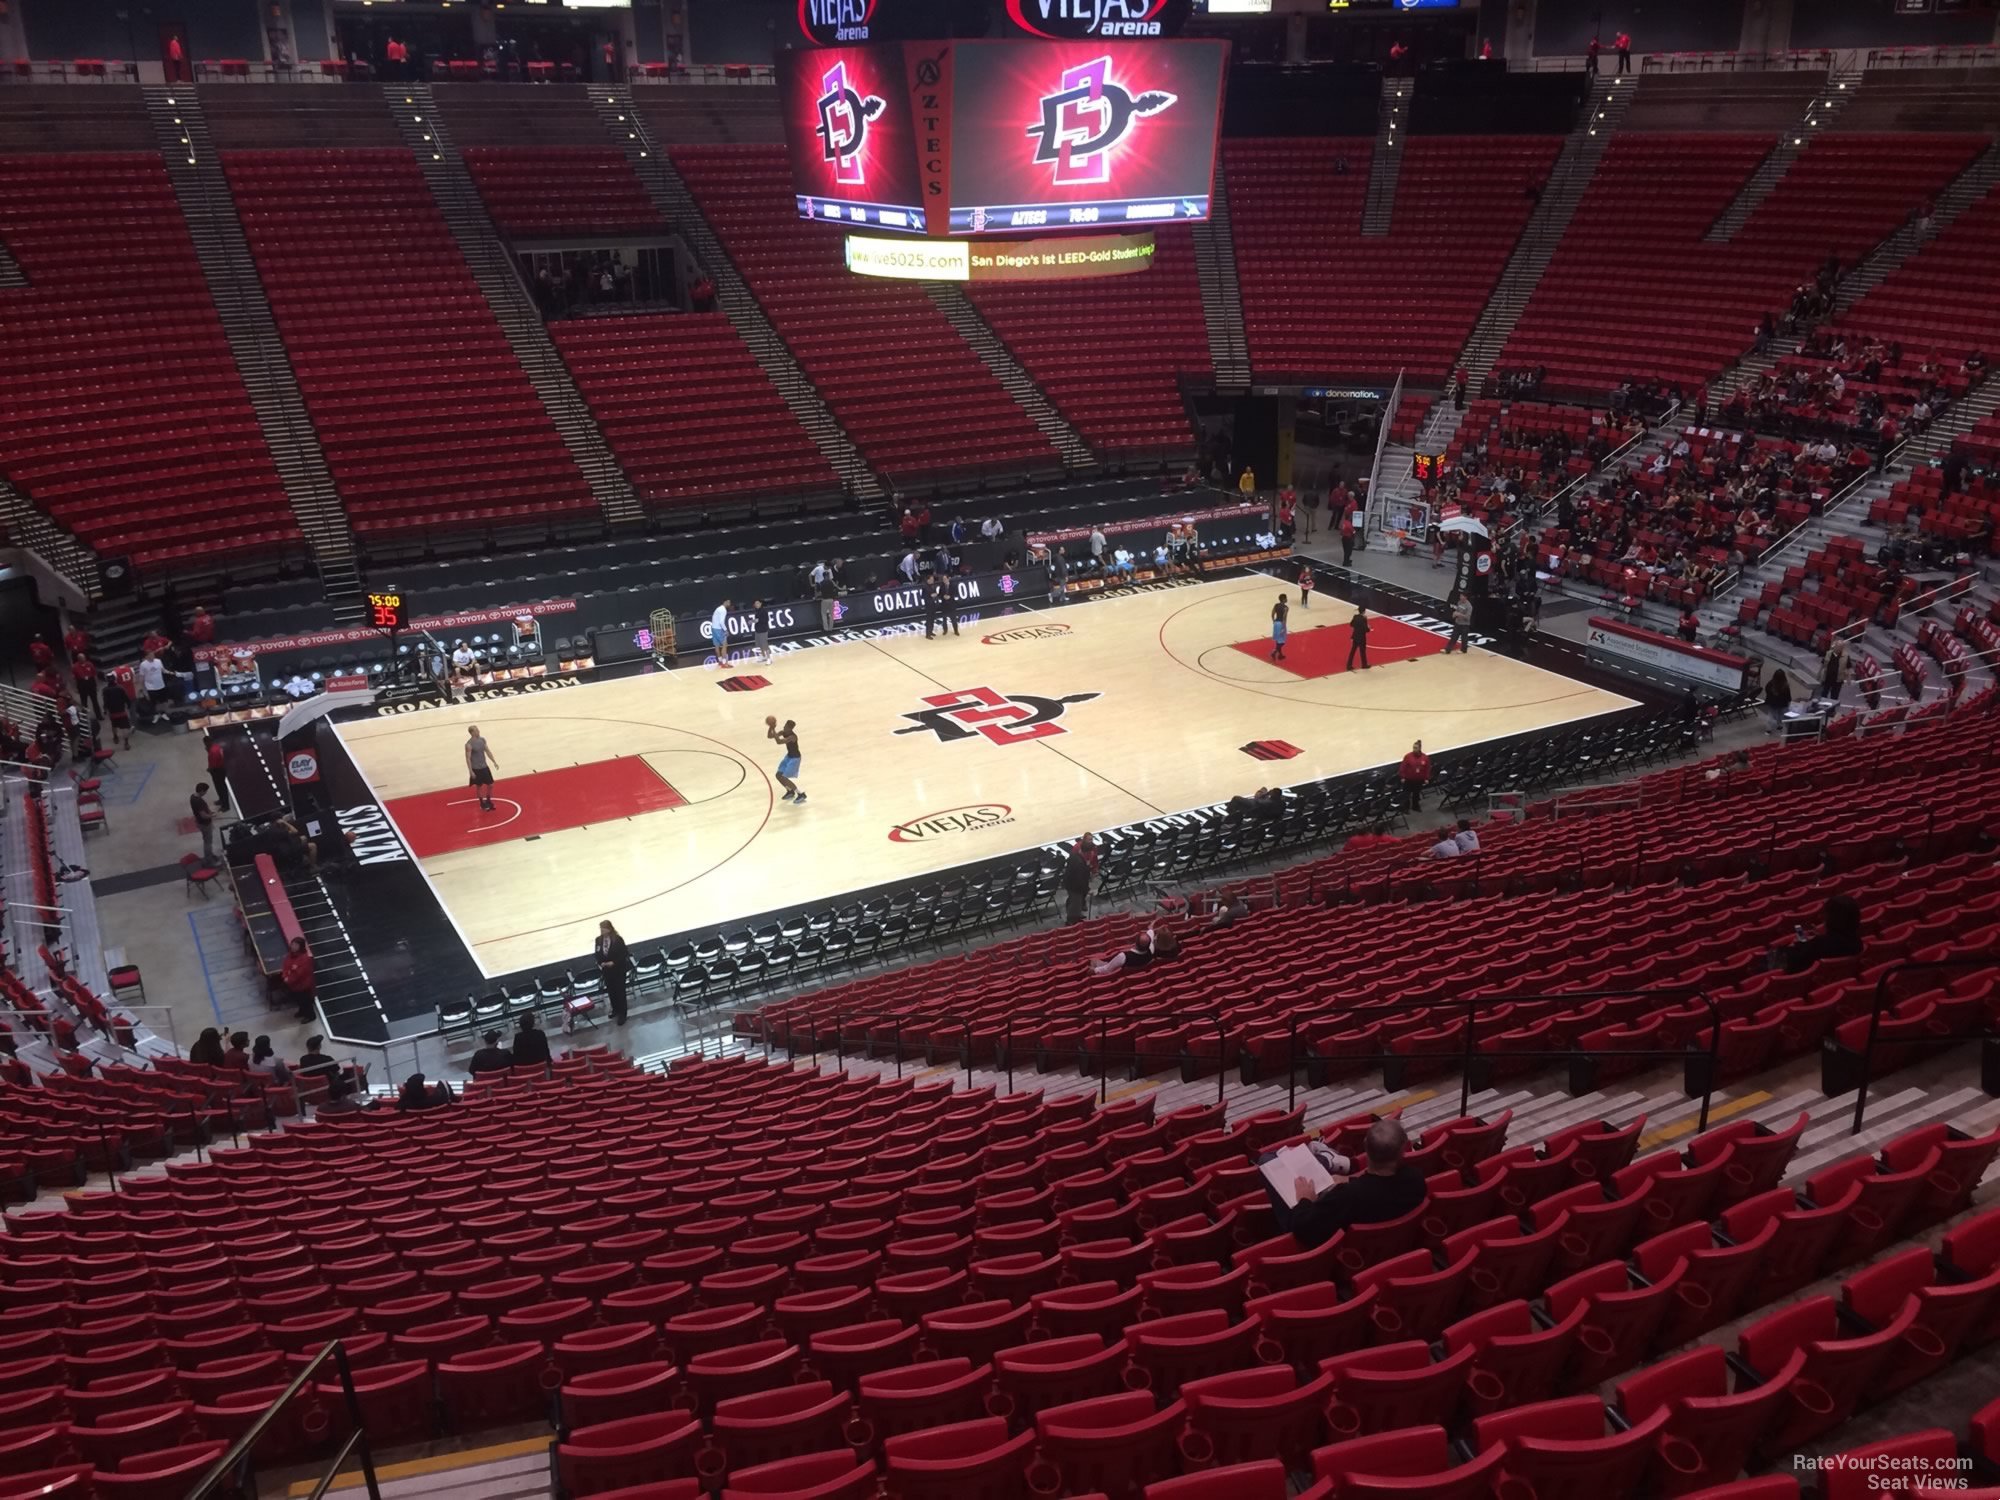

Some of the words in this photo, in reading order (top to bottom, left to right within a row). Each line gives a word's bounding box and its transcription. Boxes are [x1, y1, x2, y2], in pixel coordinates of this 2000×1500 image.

[1038, 0, 1149, 33] VIEJAS
[837, 26, 869, 40] arena
[1101, 21, 1161, 36] arena
[971, 255, 993, 267] San
[996, 254, 1040, 268] Diego's
[1058, 250, 1111, 265] LEED-Gold
[1112, 247, 1138, 260] Student
[1103, 526, 1122, 534] OYOTA
[500, 607, 532, 618] TOYOTA
[546, 601, 576, 611] TOYOTA
[374, 606, 397, 625] 35
[456, 613, 488, 624] TOYOTA
[408, 620, 442, 630] TOYOTA
[700, 608, 795, 639] @OAZECS
[311, 633, 345, 644] TOYOTA
[804, 629, 882, 648] DIEGO
[984, 625, 1063, 642] VIEJAS
[261, 640, 296, 650] TOYOTA
[377, 676, 582, 716] GOAZTECS.COM
[890, 808, 1001, 837] VIEJAS
[969, 817, 1016, 831] arena
[335, 804, 409, 866] AZTECS
